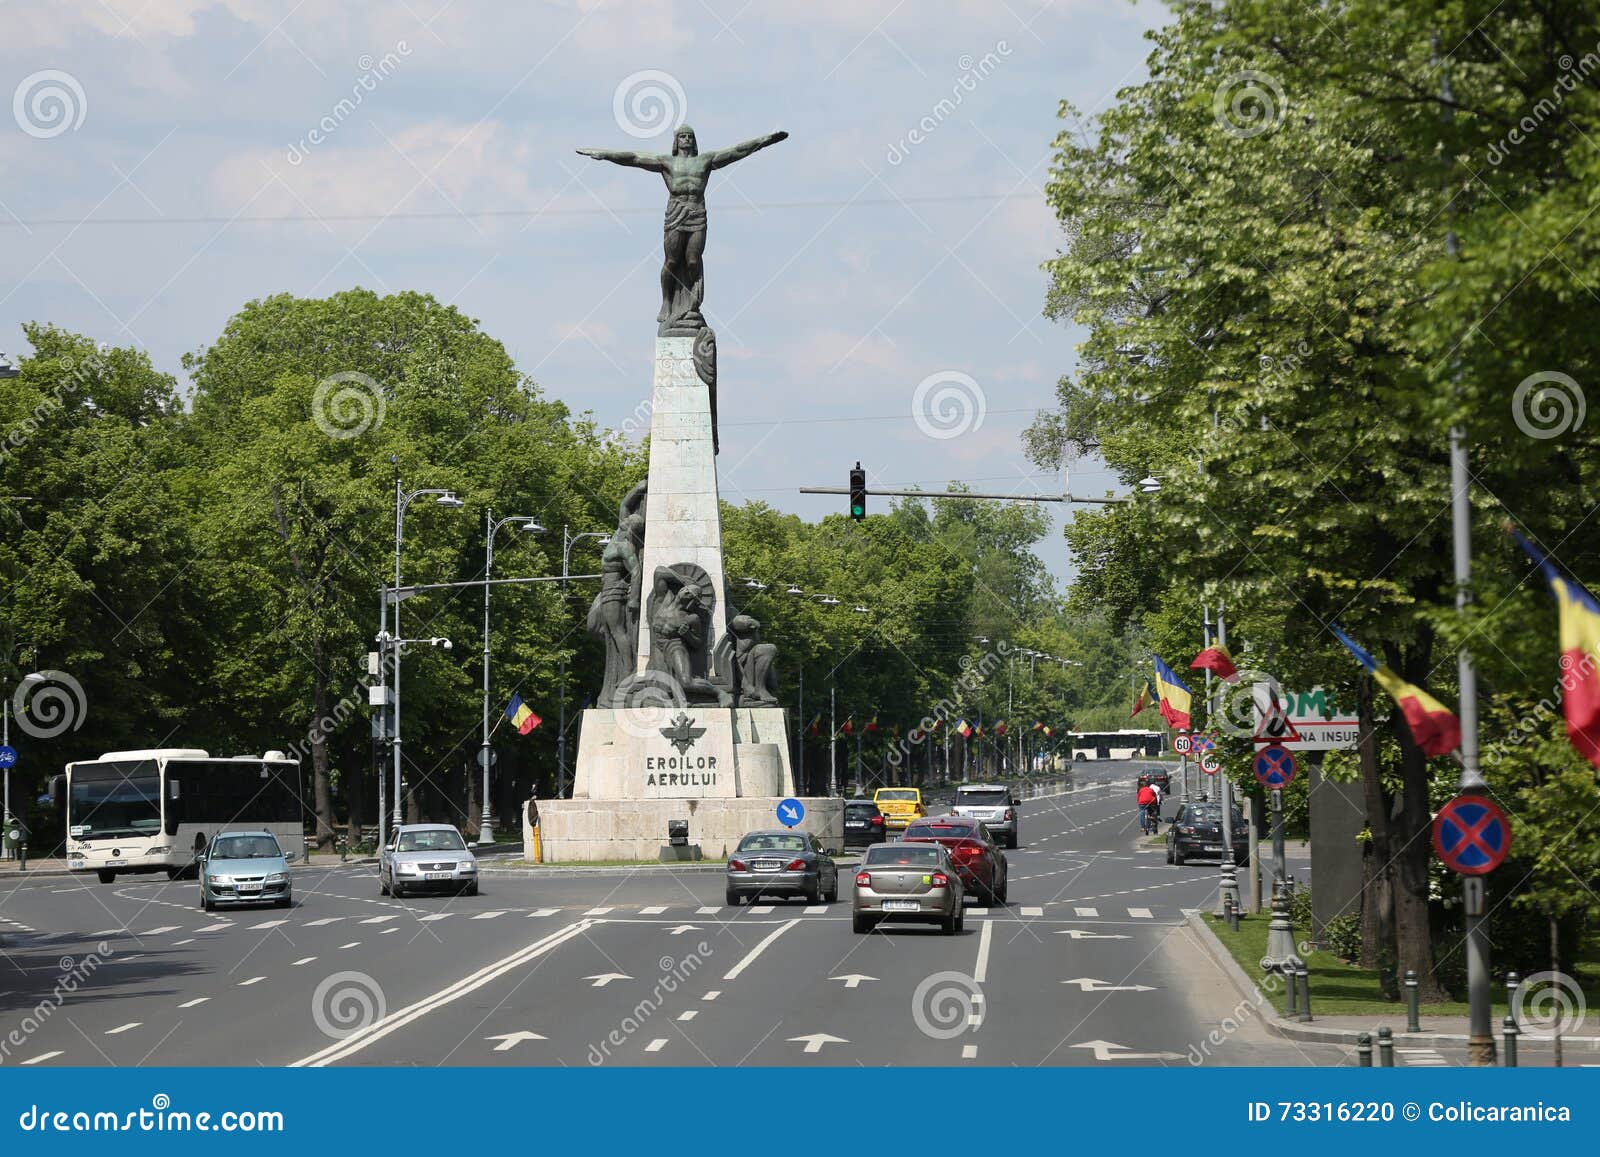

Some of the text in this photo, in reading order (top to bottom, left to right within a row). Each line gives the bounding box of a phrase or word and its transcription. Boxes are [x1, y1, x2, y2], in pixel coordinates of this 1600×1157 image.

[1321, 731, 1360, 743] INSUR
[1176, 739, 1189, 750] 60
[647, 757, 717, 769] EROILOR
[647, 773, 716, 786] AERULUI
